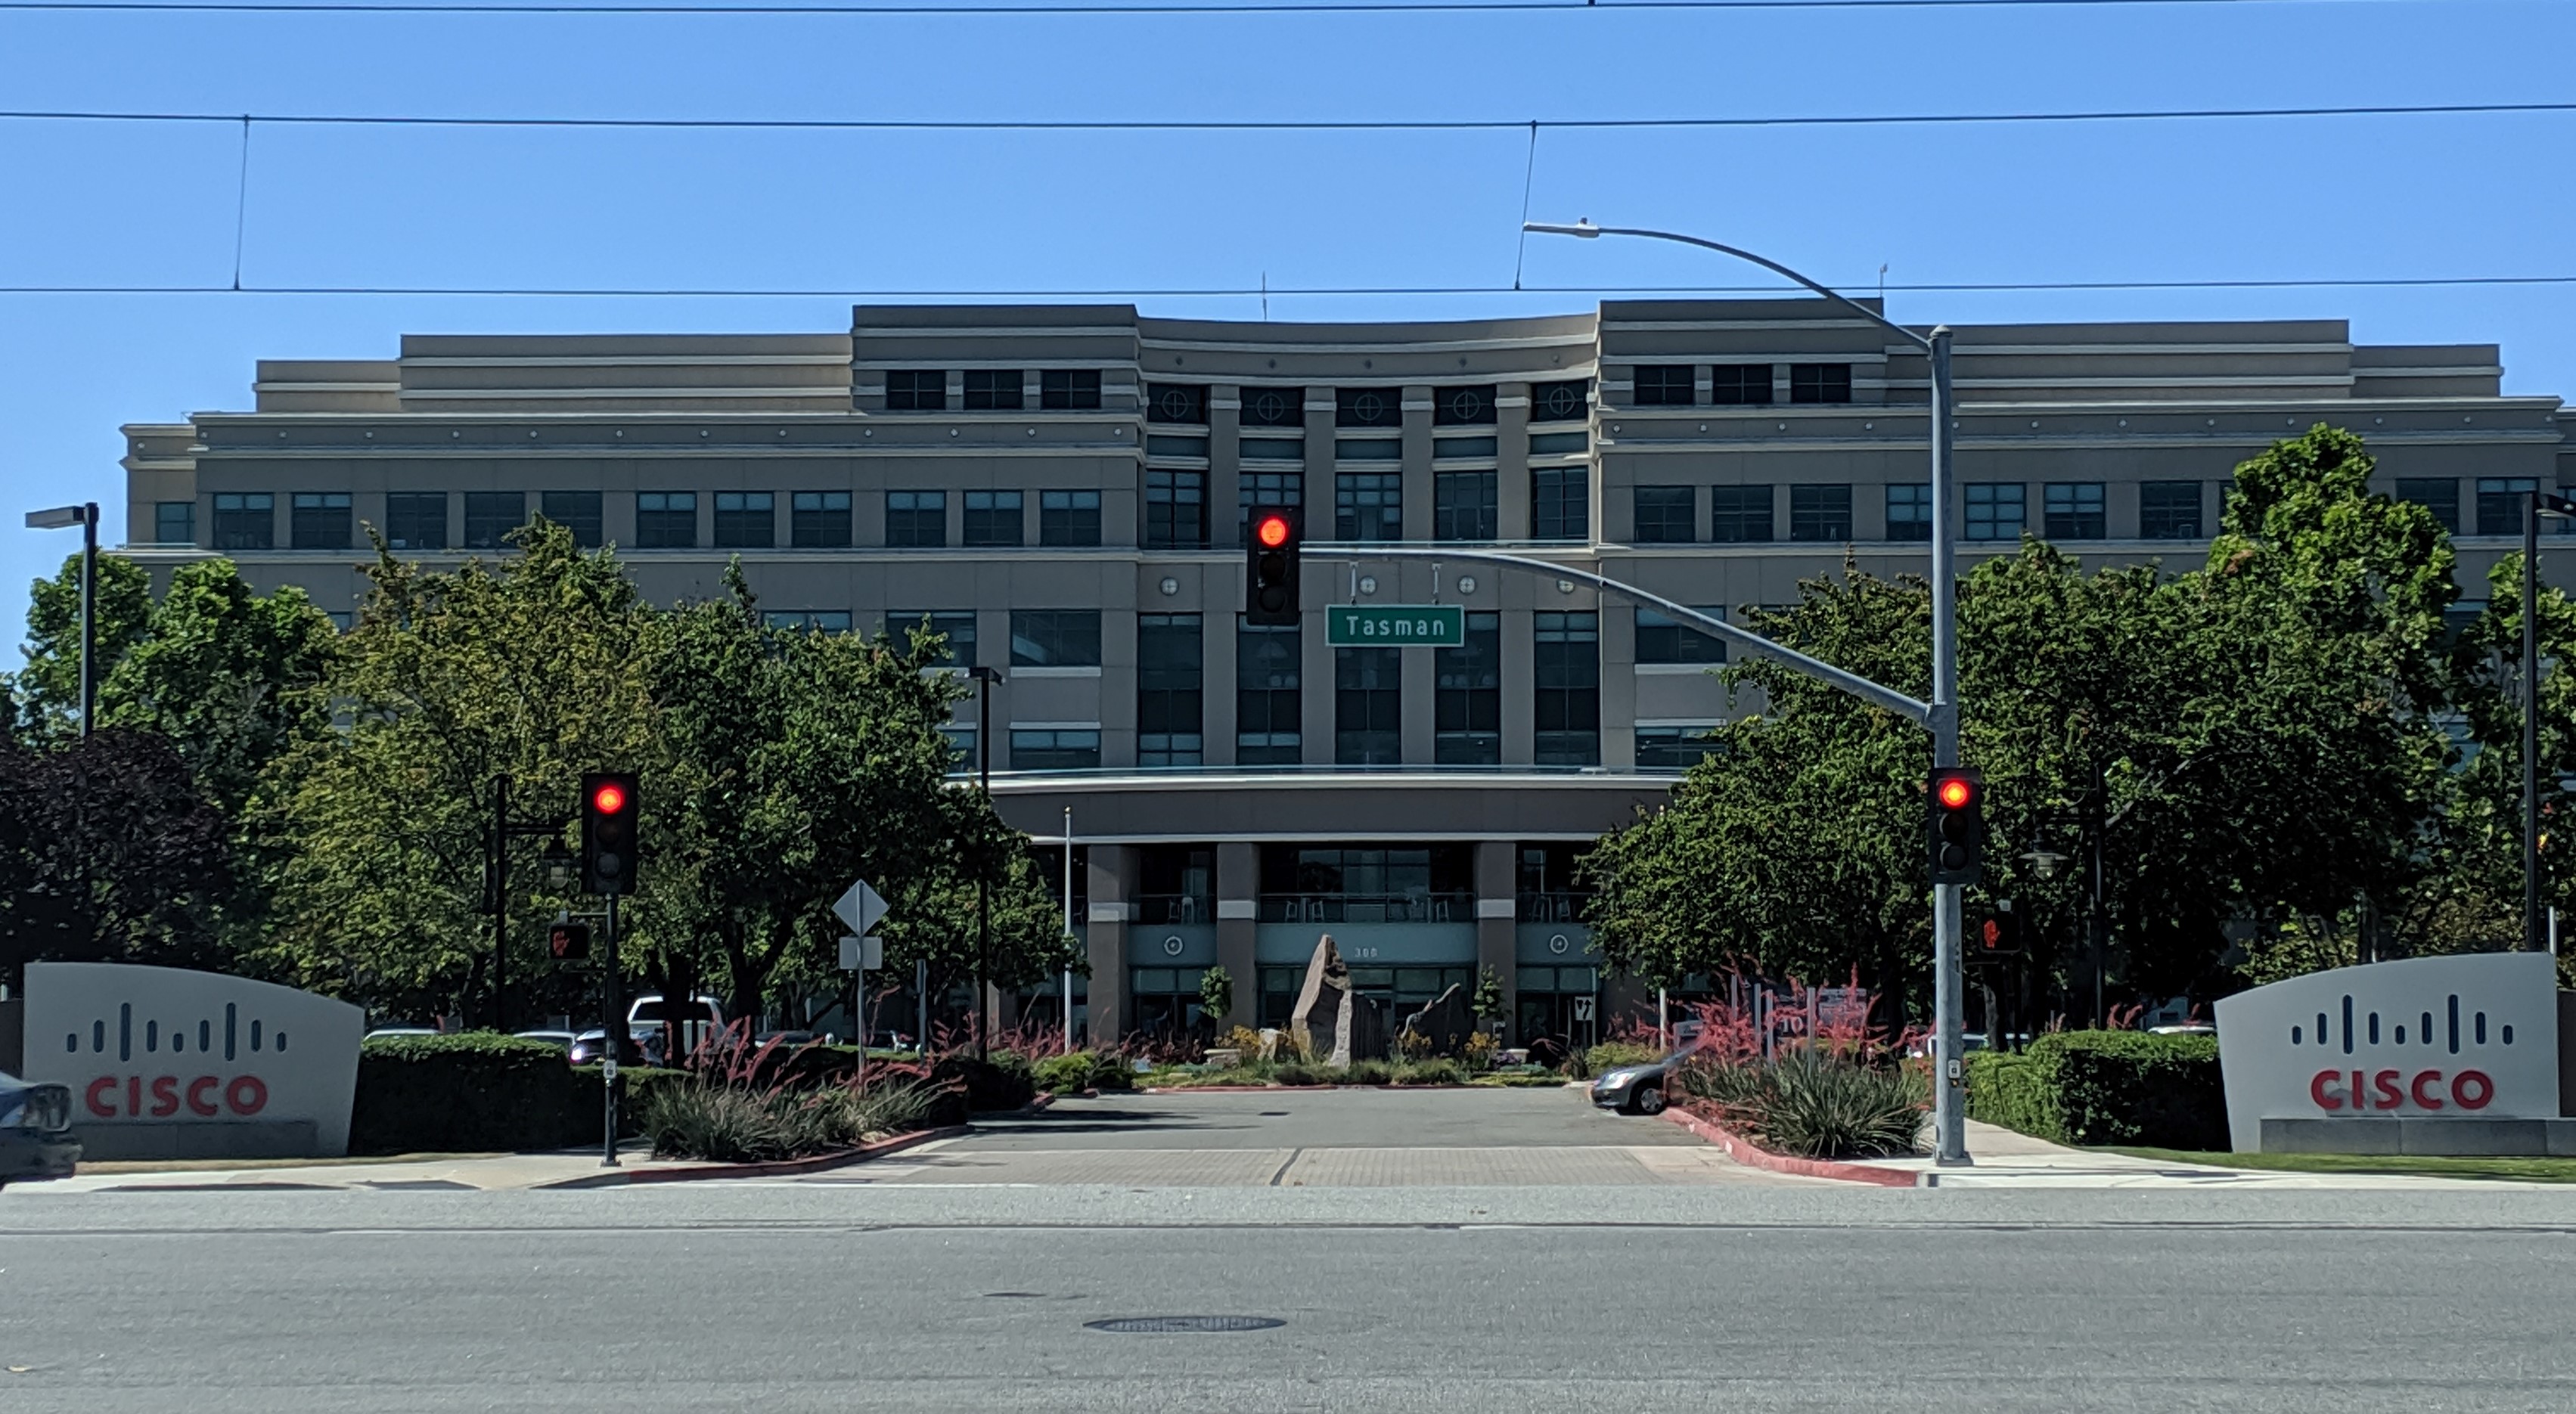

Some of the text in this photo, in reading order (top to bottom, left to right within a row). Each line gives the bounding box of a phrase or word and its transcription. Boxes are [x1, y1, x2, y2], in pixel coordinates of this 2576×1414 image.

[1346, 616, 1445, 636] Tasman
[85, 1075, 268, 1118] CISCO
[2311, 1070, 2494, 1110] CISCO
